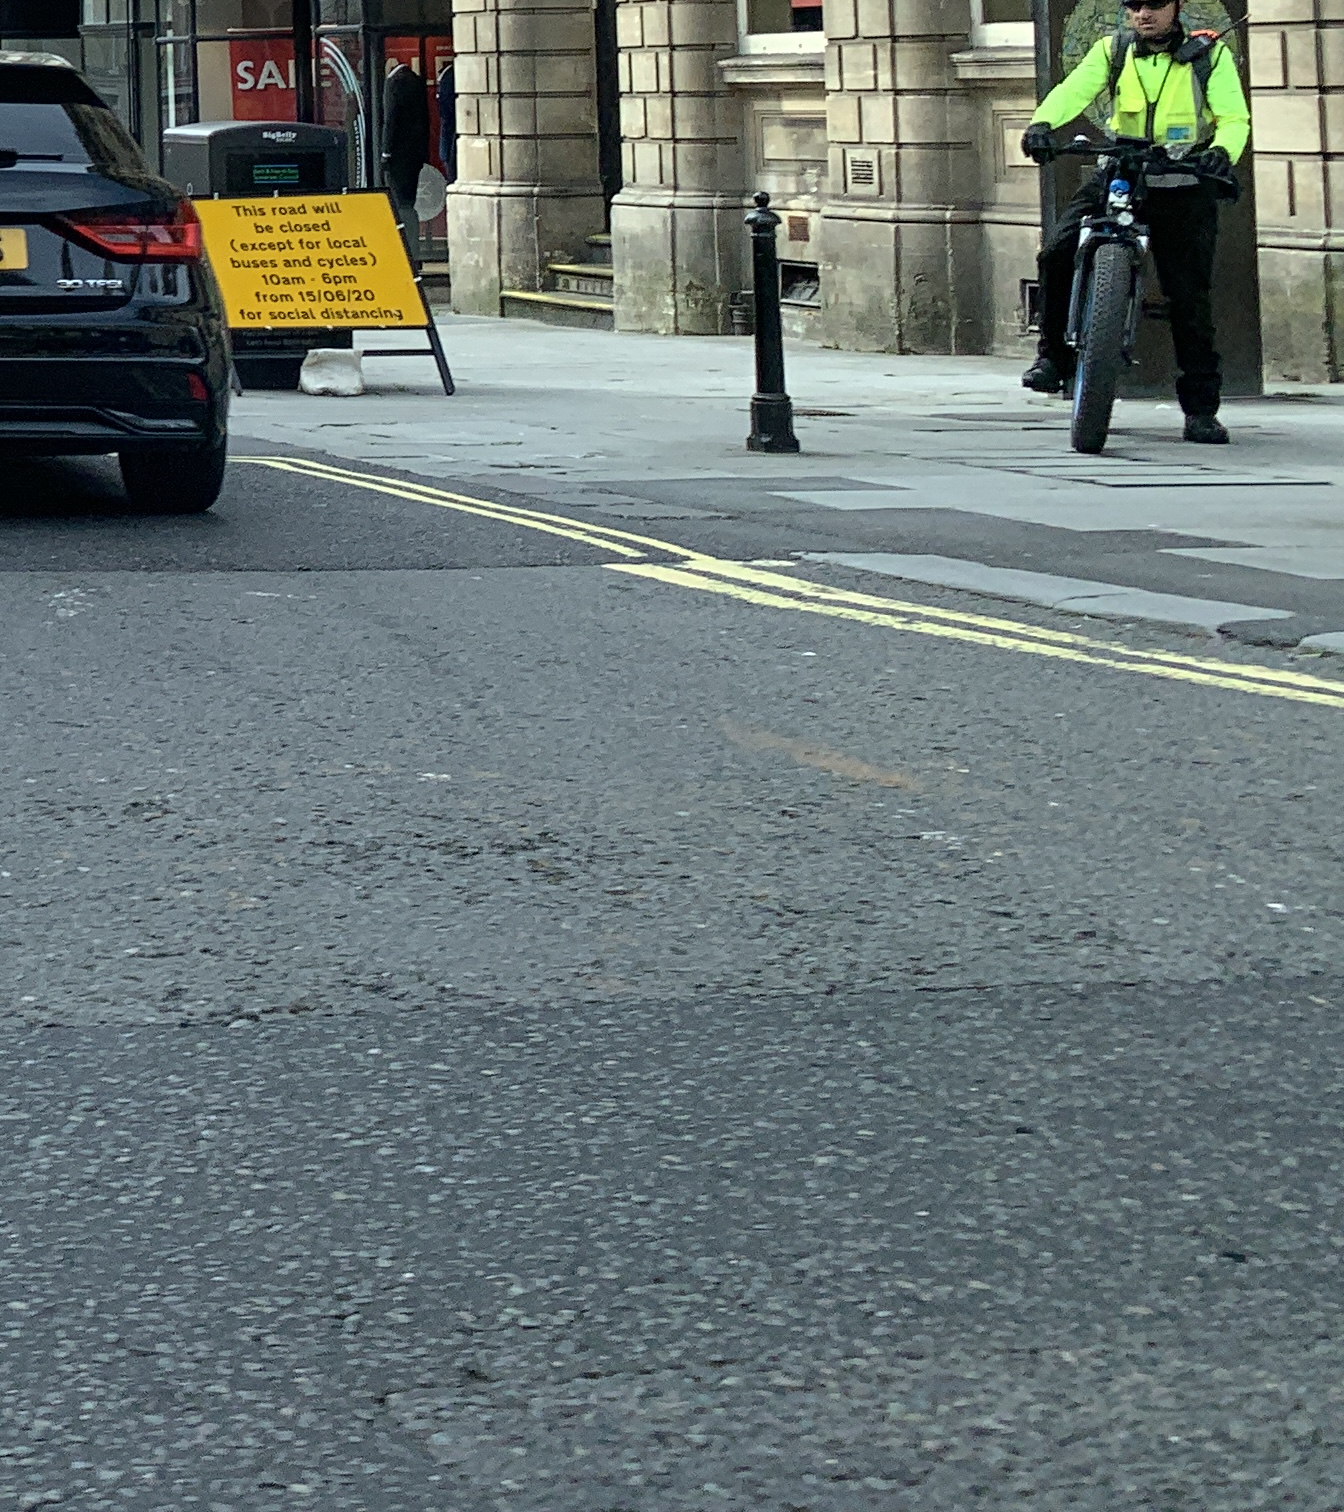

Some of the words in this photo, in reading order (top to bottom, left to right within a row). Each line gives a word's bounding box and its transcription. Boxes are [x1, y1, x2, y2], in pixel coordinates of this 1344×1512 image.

[232, 204, 266, 218] This
[271, 203, 308, 216] road
[312, 202, 342, 214] will
[254, 222, 273, 234] be
[279, 220, 331, 233] closed
[229, 238, 294, 252] (except
[298, 238, 322, 251] for
[327, 236, 367, 249] local
[230, 257, 278, 269] buses
[283, 255, 312, 268] and
[317, 252, 377, 269] cycles)
[57, 279, 83, 289] 30
[86, 279, 123, 289] TFSI
[261, 273, 306, 286] 10am
[321, 272, 357, 286] 6pm
[254, 290, 294, 303] from
[298, 288, 375, 303] 15/06/20
[239, 308, 262, 320] for
[269, 307, 317, 320] social
[320, 307, 404, 321] distancing
